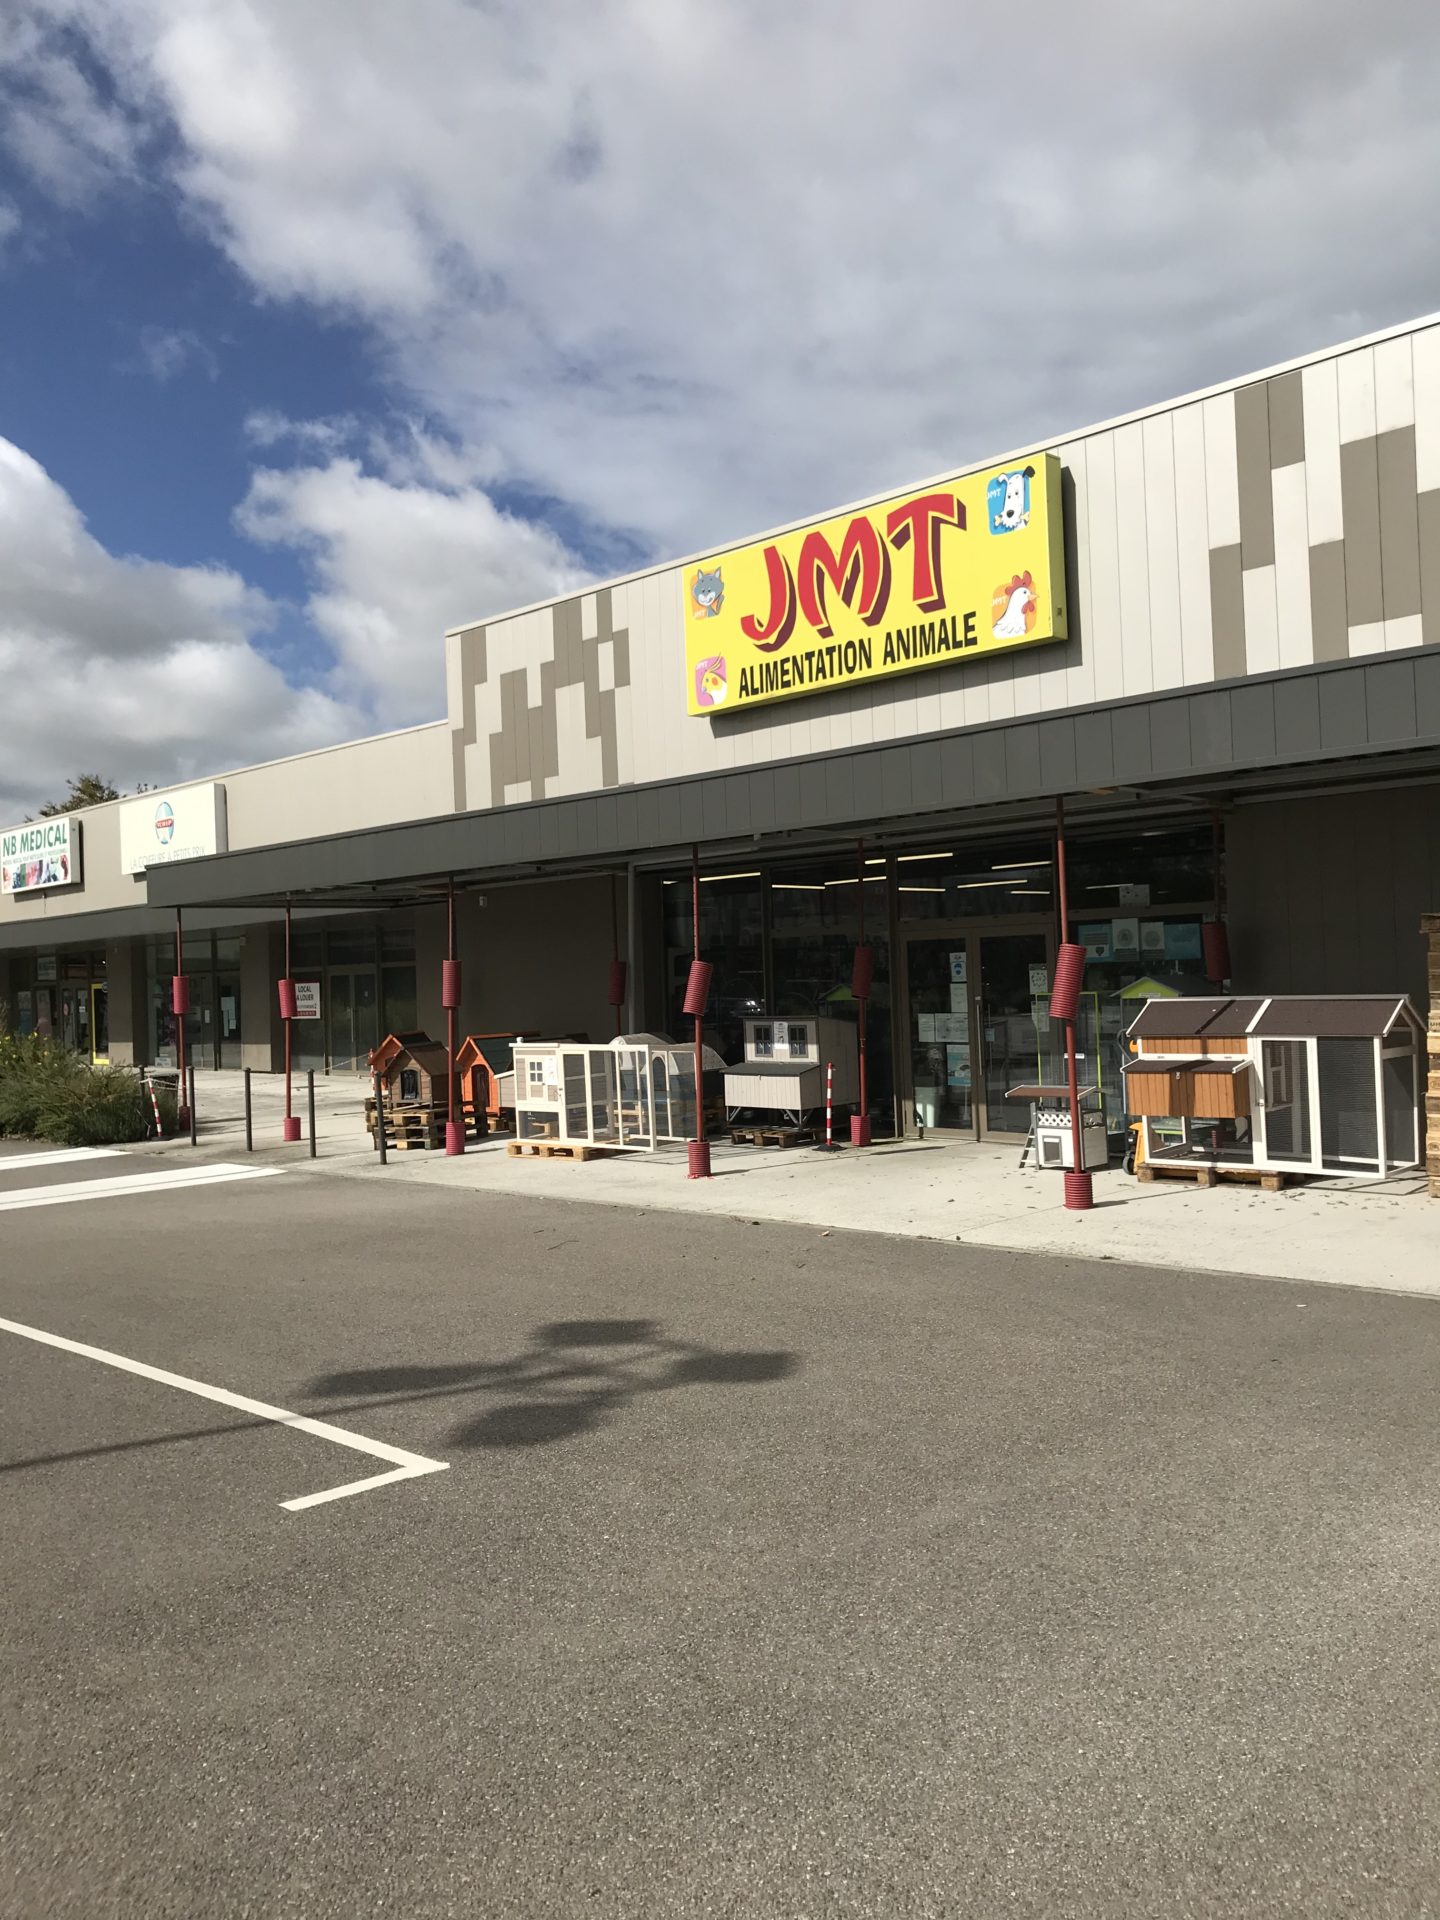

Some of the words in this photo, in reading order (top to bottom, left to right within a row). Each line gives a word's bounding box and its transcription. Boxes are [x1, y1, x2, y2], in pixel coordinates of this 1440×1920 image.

[740, 494, 967, 653] JMT
[739, 637, 872, 699] ALIMENTATION
[883, 611, 978, 666] ANIMALE
[3, 834, 17, 857] NB
[19, 823, 67, 854] MEDICAL
[297, 985, 312, 993] LOCAL
[300, 993, 314, 1001] LOUER
